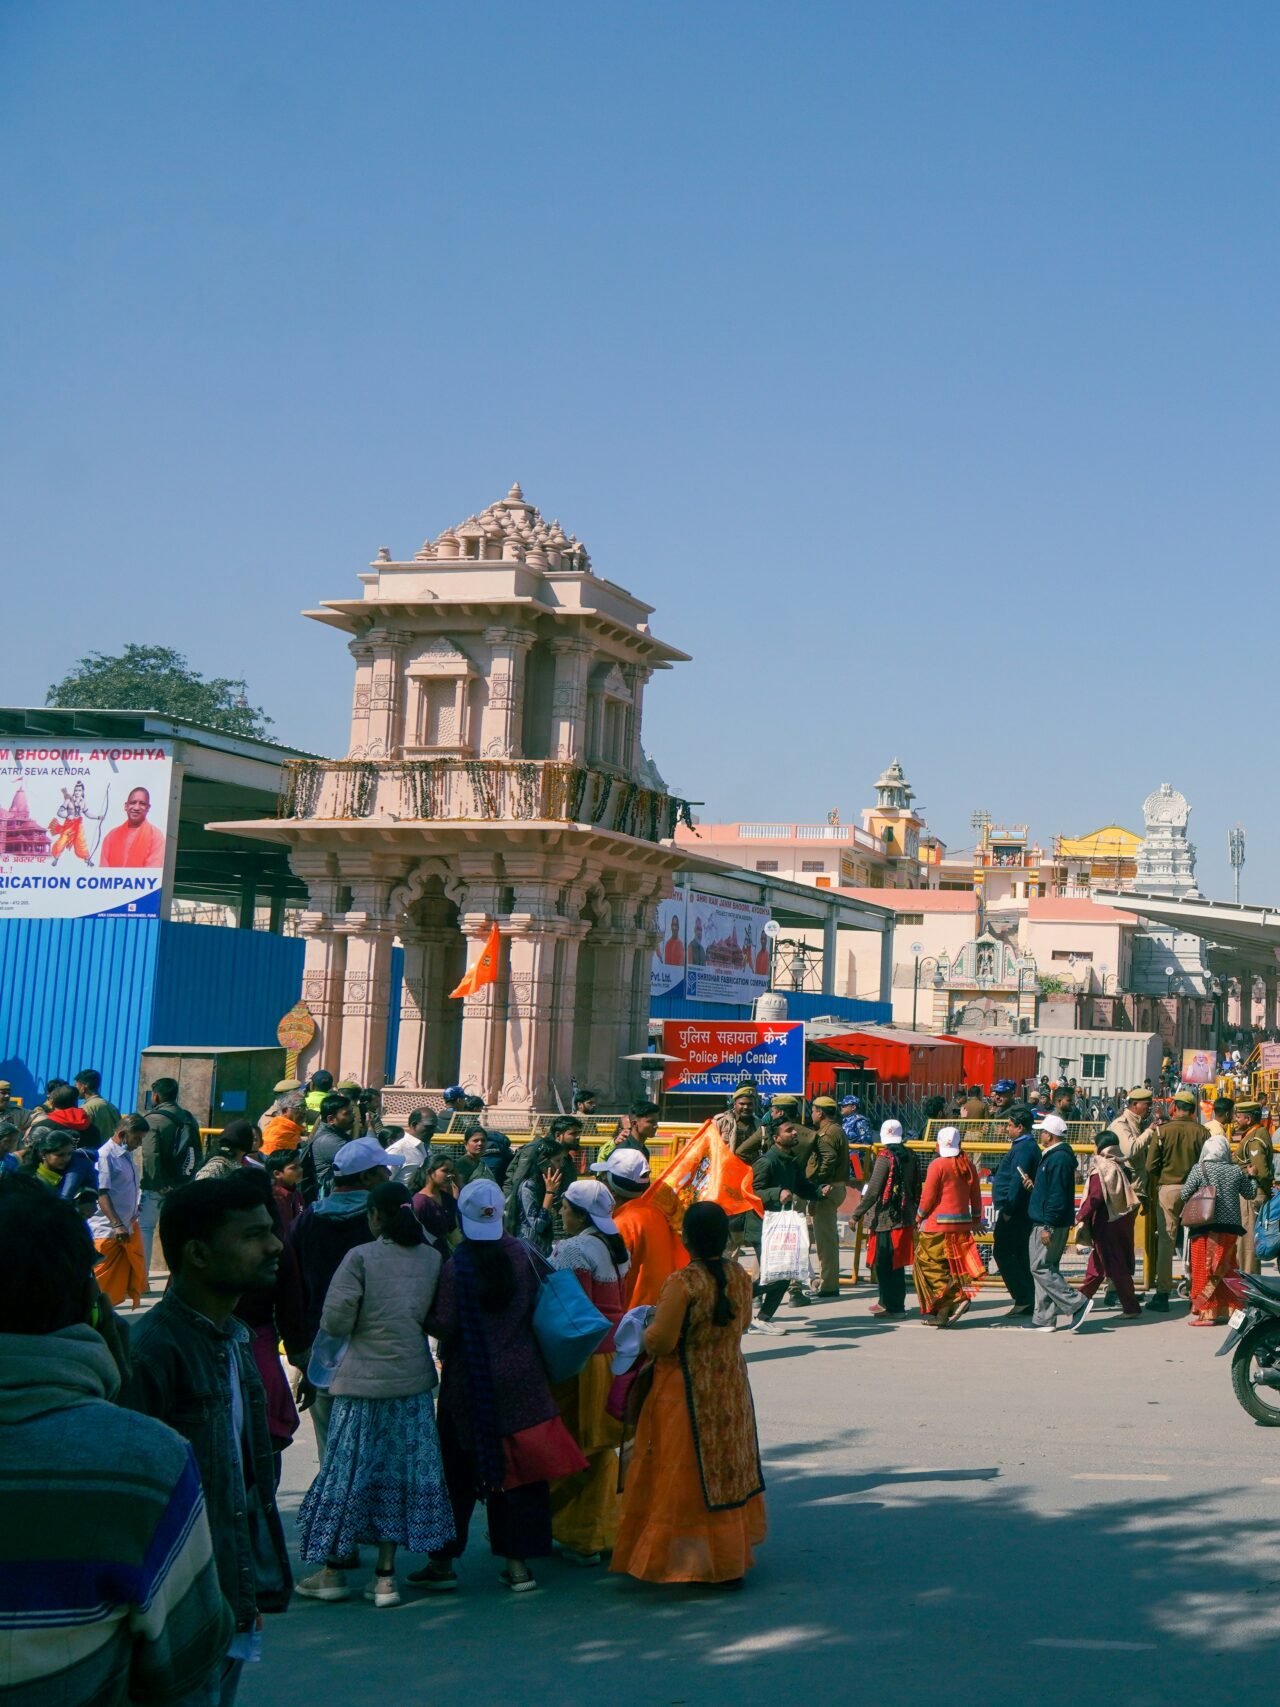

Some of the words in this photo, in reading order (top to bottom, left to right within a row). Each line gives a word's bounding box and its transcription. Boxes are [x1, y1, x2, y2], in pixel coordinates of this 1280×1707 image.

[14, 749, 84, 763] BHOOMI,
[89, 748, 166, 761] AYODHYA
[25, 767, 49, 775] SEVA
[51, 768, 90, 776] KENDRA
[76, 877, 158, 889] COMPANY
[721, 975, 749, 985] FABRICATION
[678, 1026, 711, 1048] पुलिस
[716, 1030, 758, 1045] सहायता
[762, 1027, 788, 1046] केन्द्र
[689, 1050, 717, 1063] Police
[722, 1050, 742, 1066] Help
[745, 1051, 777, 1064] Center
[678, 1068, 709, 1085] श्रीराम
[754, 1069, 787, 1086] परिसर
